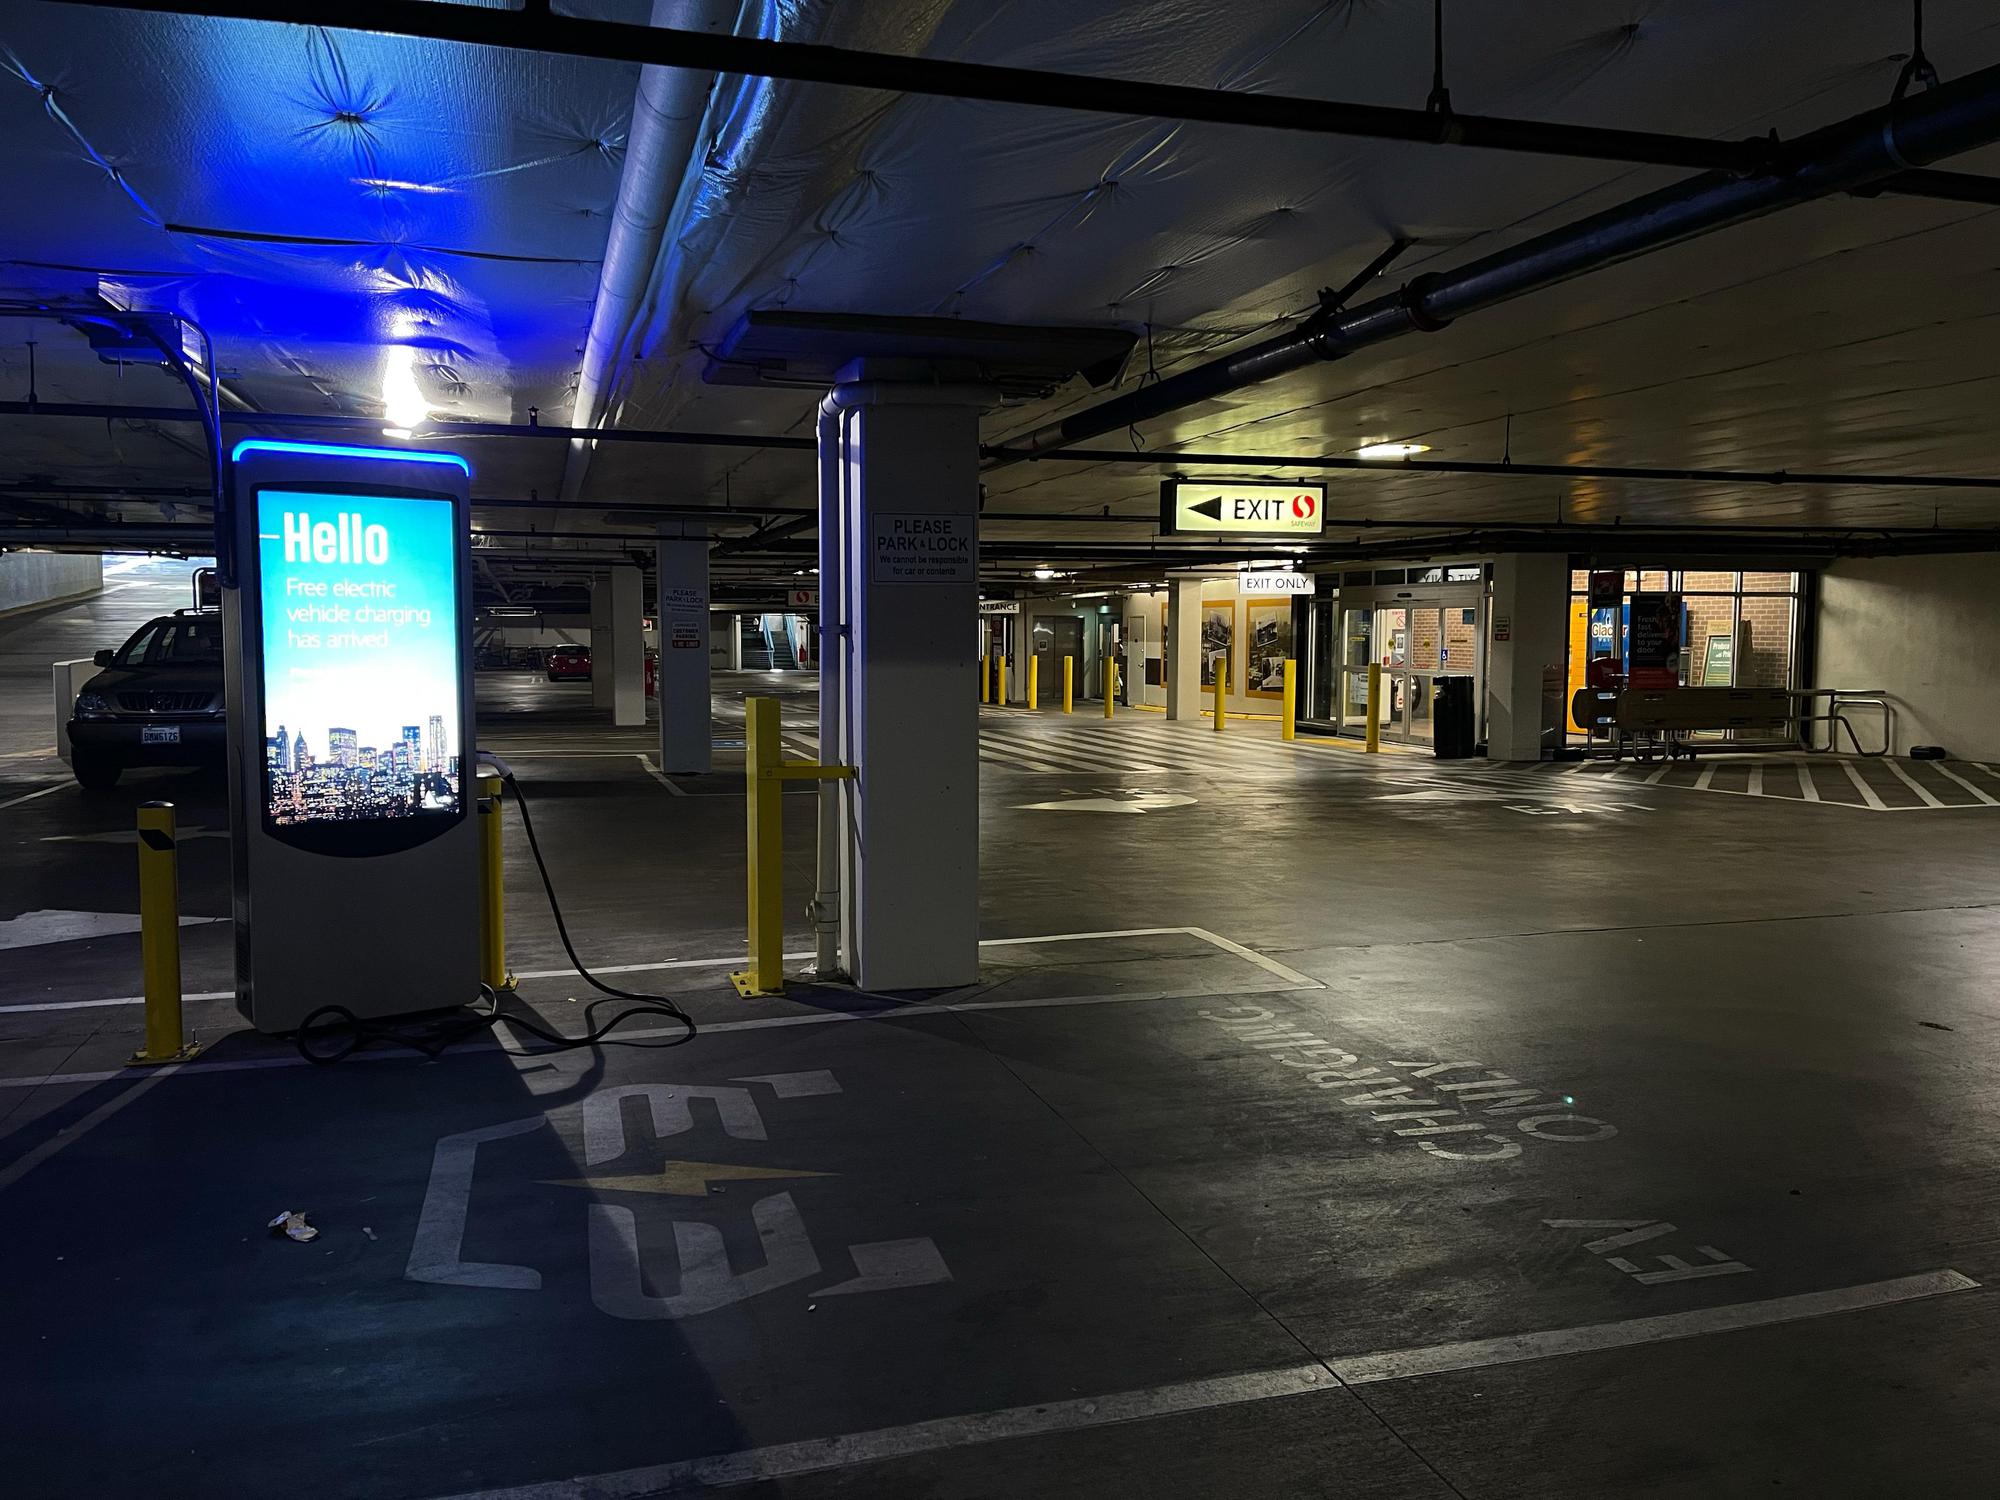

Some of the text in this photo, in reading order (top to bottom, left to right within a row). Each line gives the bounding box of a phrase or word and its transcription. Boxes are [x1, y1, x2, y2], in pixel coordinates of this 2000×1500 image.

[1234, 498, 1285, 521] EXIT
[894, 519, 952, 534] PLEASE
[283, 511, 389, 565] Hello
[877, 536, 968, 552] PARK & LOCK
[879, 555, 969, 565] We cannot be responsible
[893, 566, 956, 576] for car or contents
[286, 577, 397, 597] Free electric
[672, 589, 697, 597] PLEASE
[1246, 577, 1309, 589] EXIT ONLY
[286, 603, 431, 628] vehicle charging
[979, 603, 1017, 611] NTRANCE
[287, 628, 389, 649] has arrived
[1197, 1005, 1523, 1162] CHARGING
[1387, 1060, 1619, 1143] ONLY
[1541, 1218, 1755, 1286] EV
